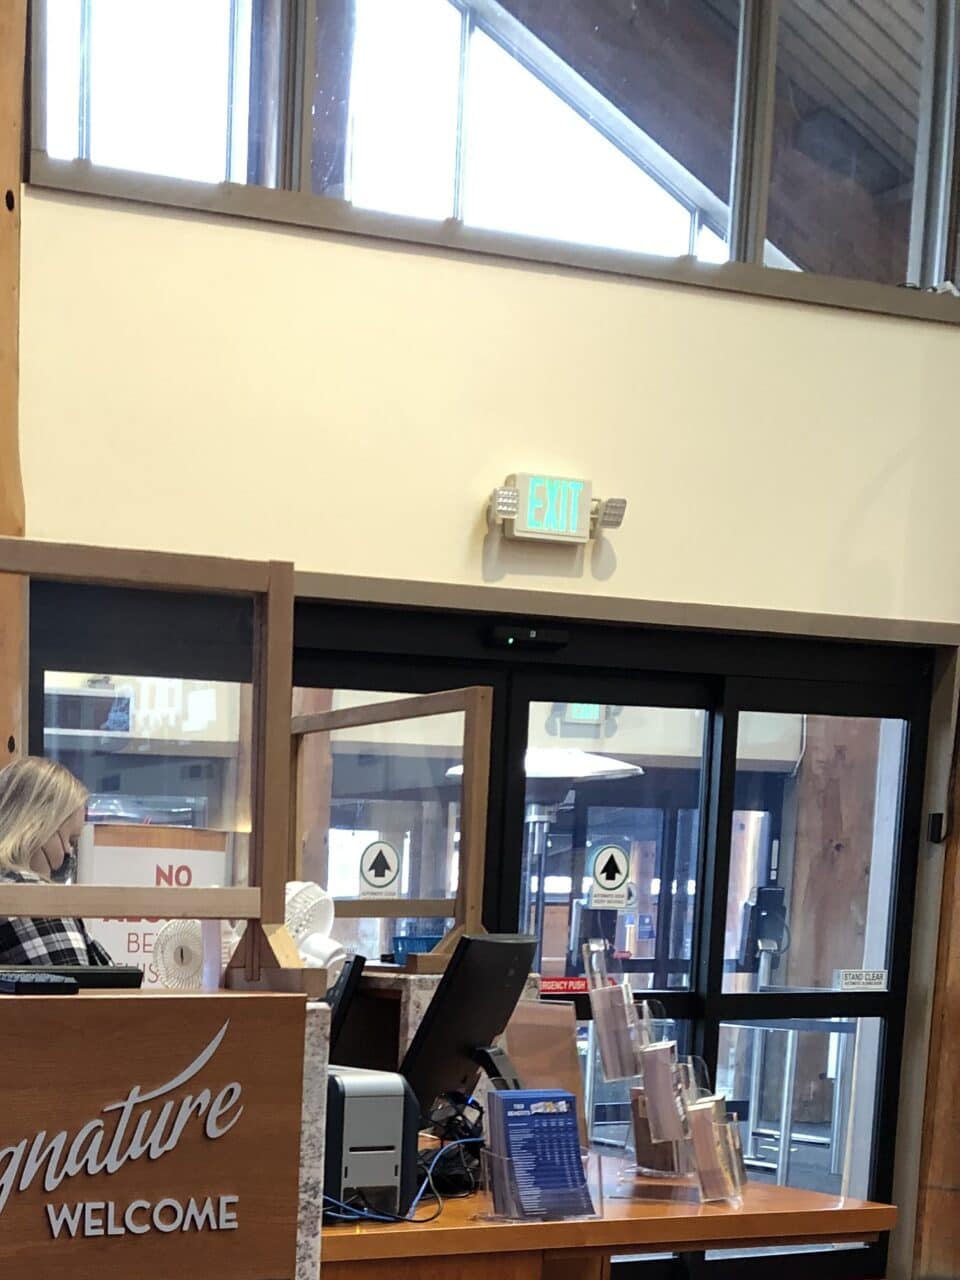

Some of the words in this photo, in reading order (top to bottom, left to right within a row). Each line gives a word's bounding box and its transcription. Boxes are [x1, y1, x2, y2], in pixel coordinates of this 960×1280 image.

[527, 476, 584, 532] EXIT
[155, 864, 193, 887] NO
[568, 980, 586, 990] PUSH
[46, 1195, 240, 1239] WELCOME
